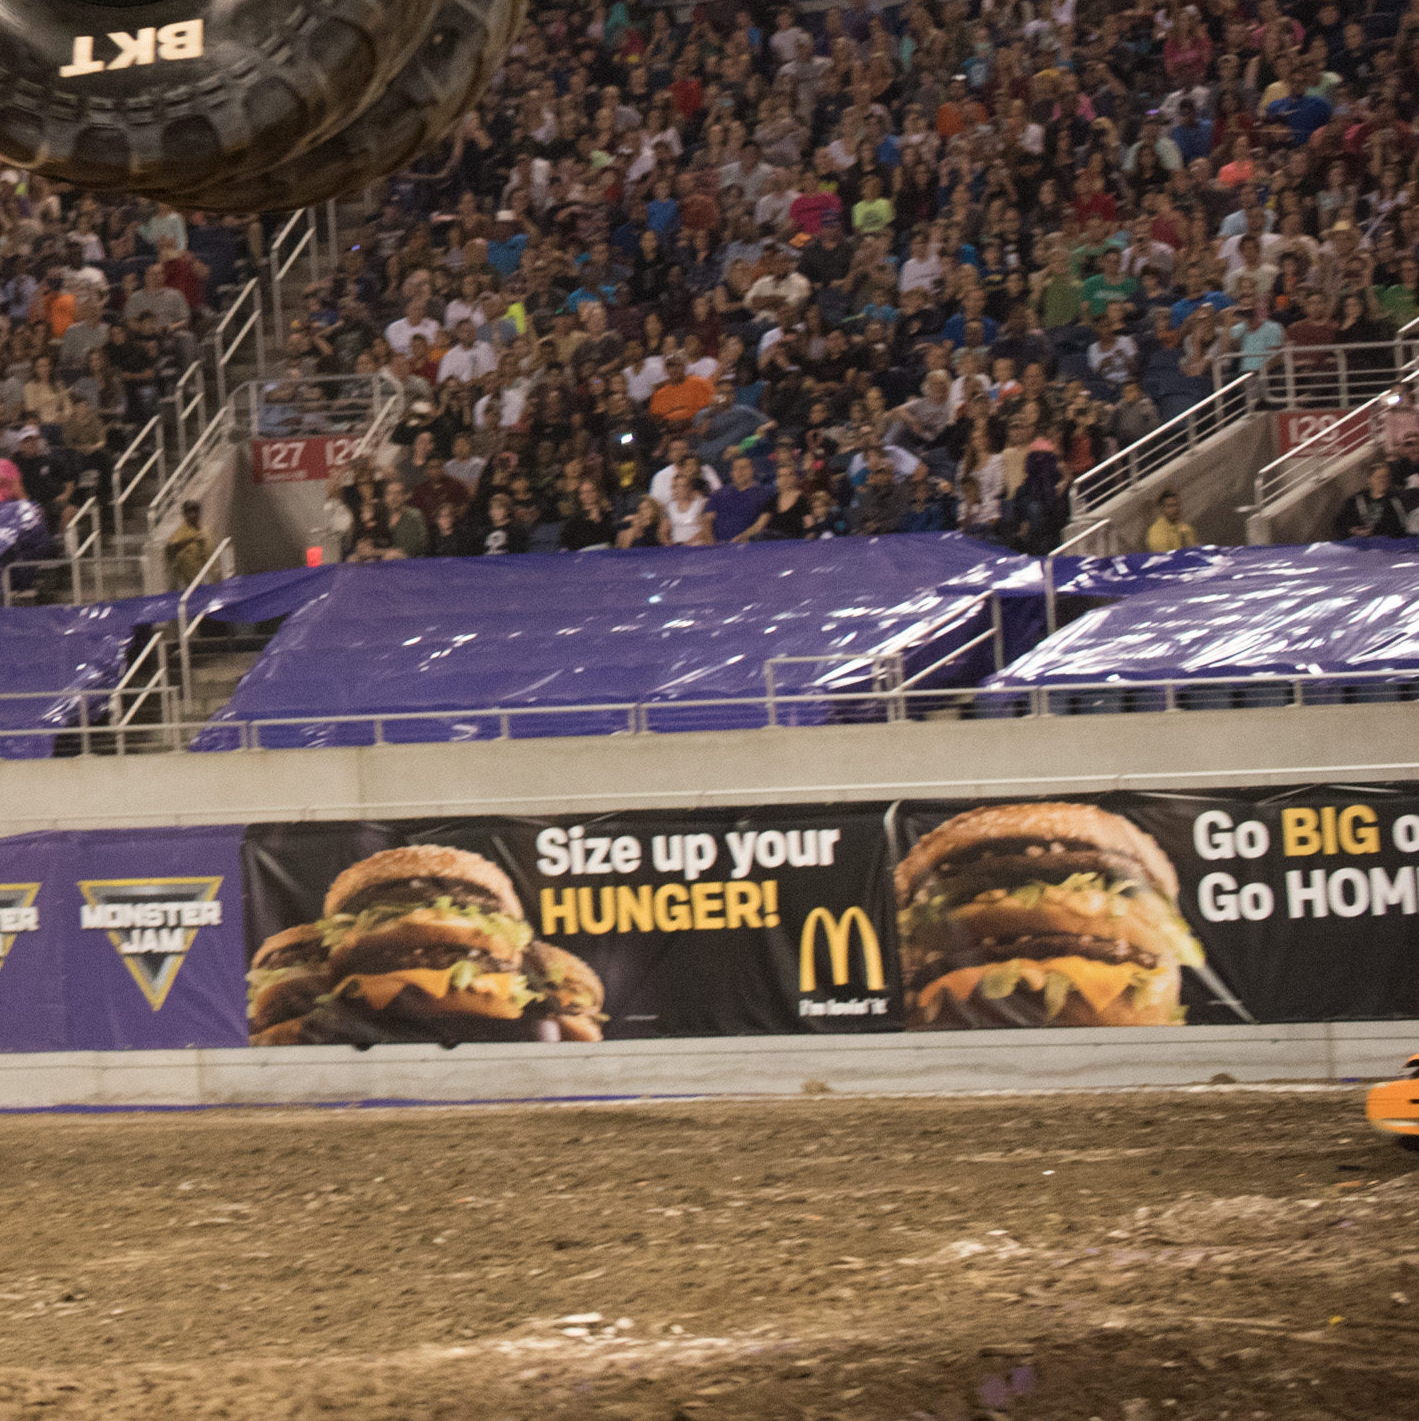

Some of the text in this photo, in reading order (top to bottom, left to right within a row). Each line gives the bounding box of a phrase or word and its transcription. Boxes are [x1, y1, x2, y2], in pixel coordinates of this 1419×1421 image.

[59, 18, 204, 78] BKT
[262, 440, 307, 470] 127
[536, 826, 841, 881] Size up your
[1193, 809, 1270, 861] Go
[1281, 804, 1381, 857] BIG
[80, 900, 223, 930] MONSTER
[540, 880, 780, 935] HUNGER!
[1198, 866, 1419, 922] Go HOM
[120, 927, 187, 954] JAM
